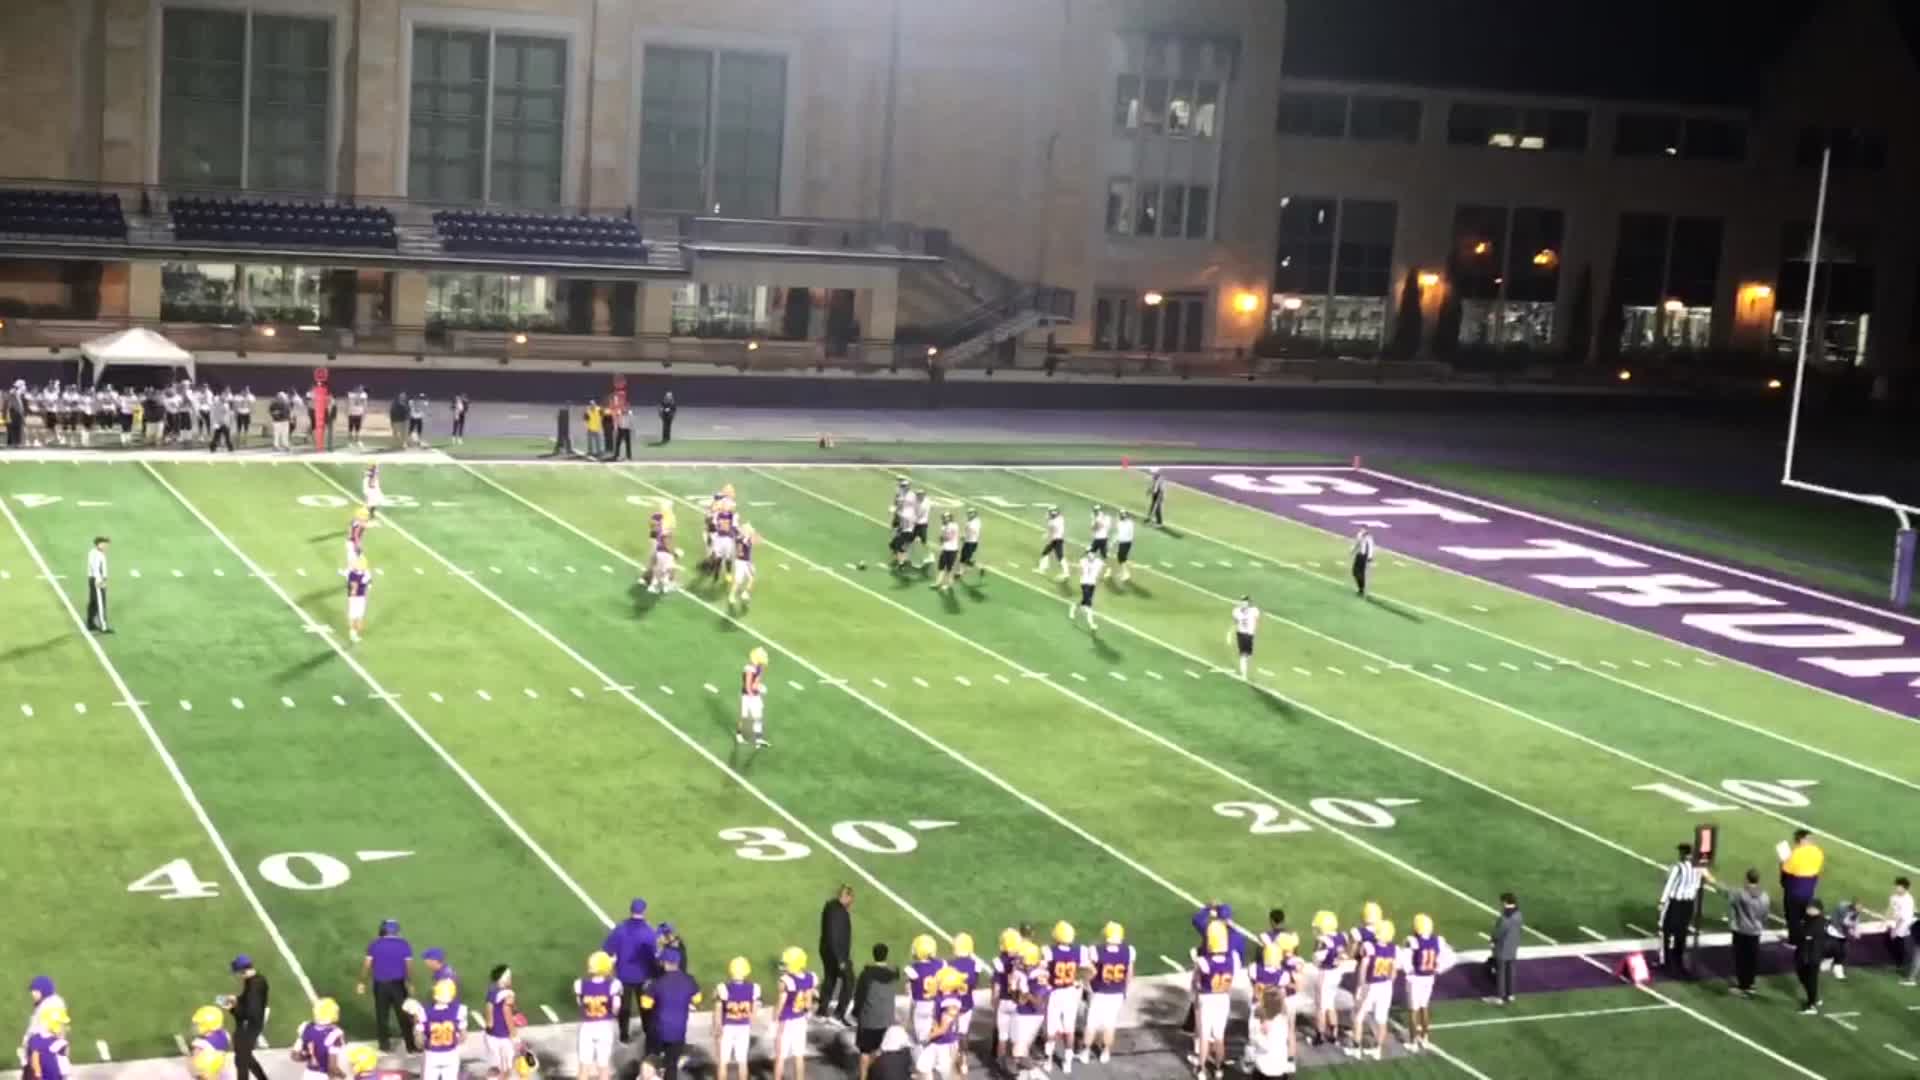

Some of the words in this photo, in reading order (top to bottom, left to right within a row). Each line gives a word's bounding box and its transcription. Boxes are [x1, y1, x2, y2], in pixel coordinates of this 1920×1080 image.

[1436, 538, 1920, 699] THO
[1212, 797, 1396, 834] 20
[718, 820, 918, 861] 30
[127, 852, 351, 900] 40
[1054, 961, 1077, 986] 93
